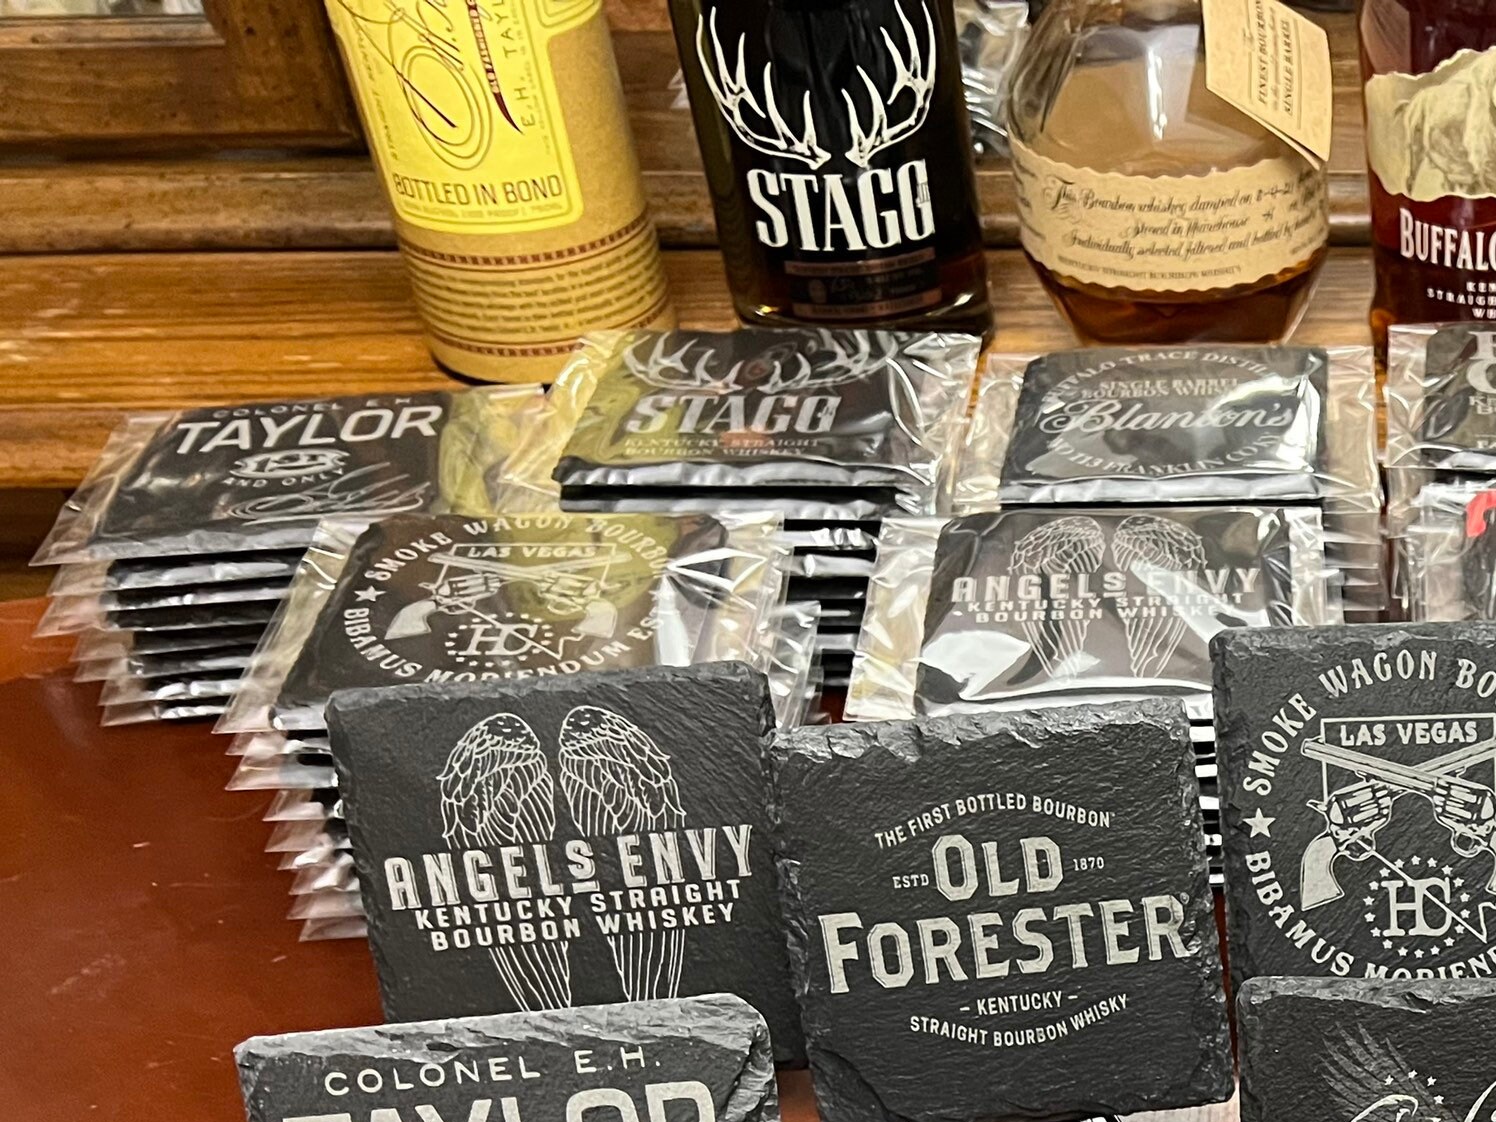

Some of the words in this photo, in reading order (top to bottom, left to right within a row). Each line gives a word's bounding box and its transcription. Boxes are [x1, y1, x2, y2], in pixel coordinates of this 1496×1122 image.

[392, 173, 470, 205] BOTTLED
[472, 183, 497, 205] IN
[503, 174, 562, 204] BOND
[747, 158, 936, 251] STAGG
[1122, 350, 1199, 365] TRACE
[176, 404, 444, 455] TAYLOR
[213, 401, 343, 418] COLONEL
[625, 394, 842, 434] STAGG
[1039, 399, 1292, 435] Blanton's
[624, 438, 725, 448] KENTUCKY
[731, 437, 820, 448] STRAIGHT
[624, 447, 719, 457] BOURBON
[723, 446, 806, 456] WHISKEY
[222, 476, 266, 488] AND
[280, 467, 345, 487] ONLY
[364, 531, 454, 582] SMOKE
[463, 516, 573, 537] WAGON
[466, 546, 511, 559] LAS
[521, 545, 597, 559] VEGAS
[952, 571, 1127, 603] ANGELS
[1145, 568, 1261, 594] ENVY
[967, 598, 1101, 612] KENTUCKY
[975, 608, 1104, 624] BOURBON
[344, 608, 423, 679] BIBAMUS
[1243, 692, 1317, 796] SMOKE
[1318, 649, 1438, 699] WAGON
[1339, 723, 1386, 747] LAS
[1396, 721, 1478, 745] VEGAS
[874, 826, 906, 850] THE
[906, 803, 952, 843] FIRST
[955, 792, 1027, 817] BOTTLED
[1032, 796, 1113, 829] BOURBON
[384, 839, 600, 911] ANGELS
[617, 824, 753, 888] ENVY
[892, 873, 930, 890] ESTD
[931, 833, 1064, 902] OLD
[1072, 856, 1106, 872] 1870
[415, 895, 572, 930] KENTUCKY
[591, 879, 741, 913] STRAIGHT
[430, 917, 581, 952] BOURBON
[596, 902, 735, 936] WHISKEY
[1245, 850, 1355, 976] BIBAMUS
[817, 893, 1200, 994] FORESTER
[909, 1016, 988, 1047] STRAIGHT
[993, 1020, 1069, 1048] BOURBON
[1071, 993, 1130, 1032] WHISKY
[976, 990, 1063, 1017] KENTUCKY
[323, 1056, 541, 1096] COLONEL
[574, 1046, 662, 1075] E.H.
